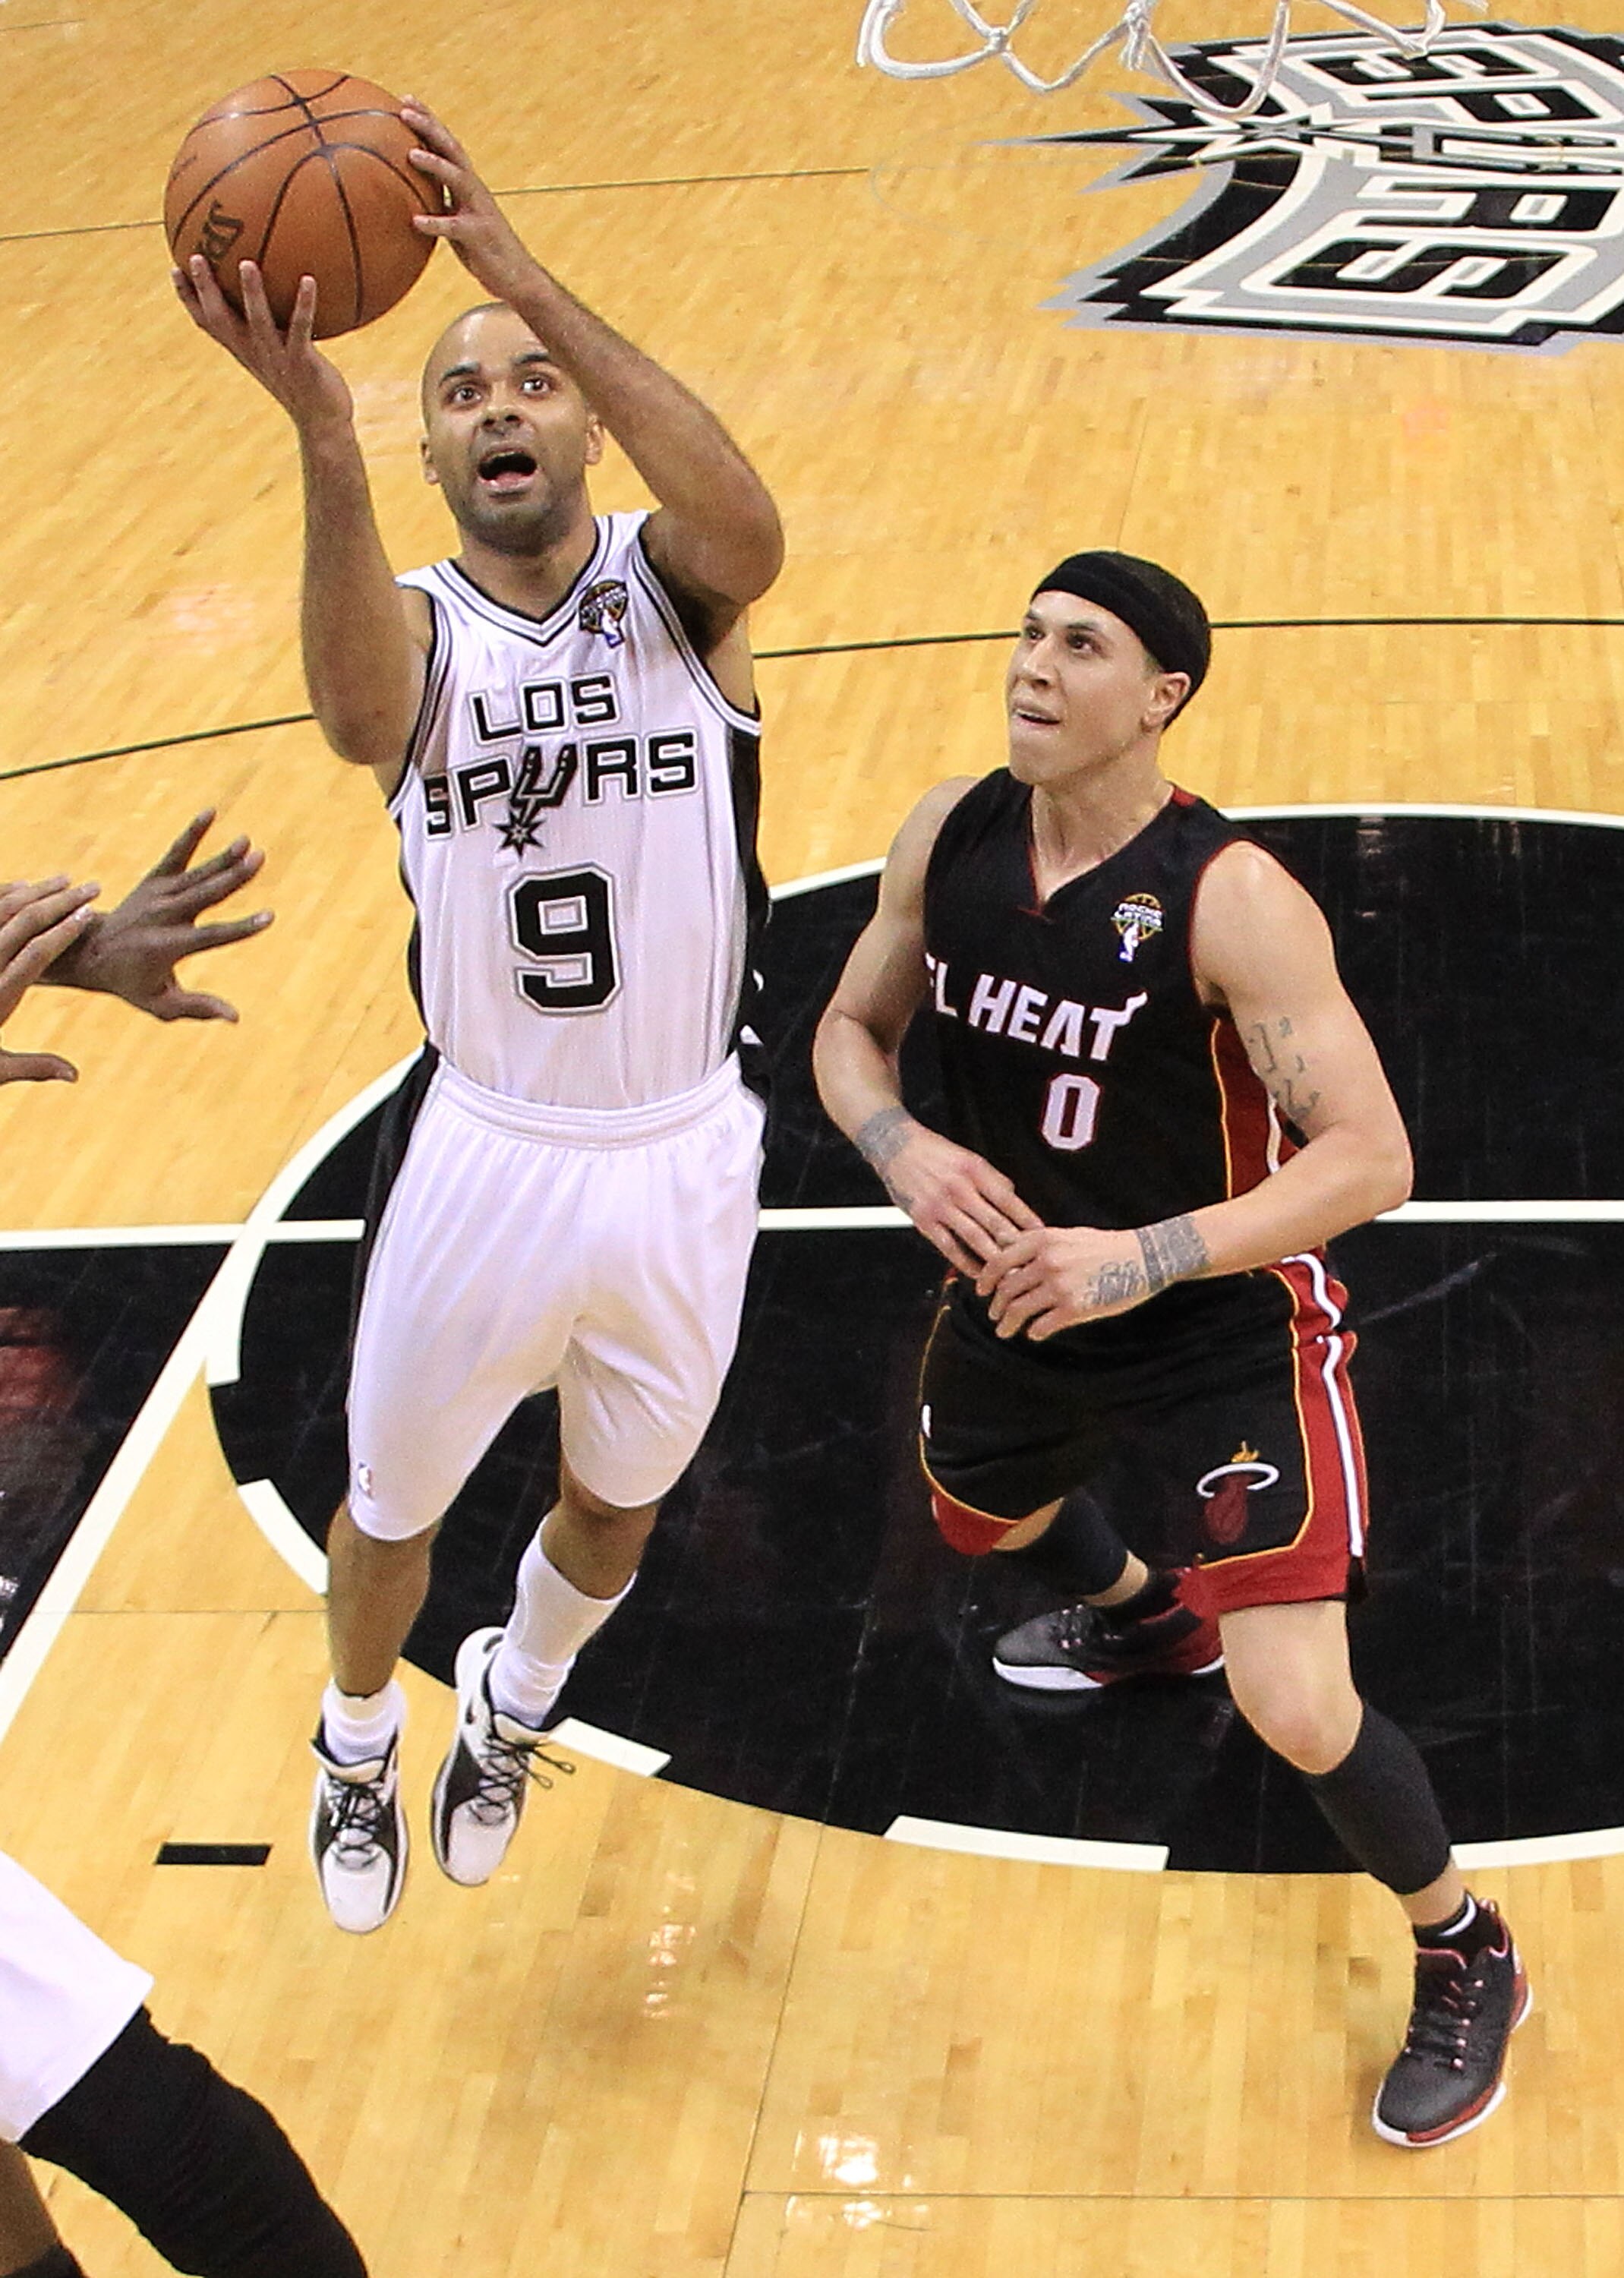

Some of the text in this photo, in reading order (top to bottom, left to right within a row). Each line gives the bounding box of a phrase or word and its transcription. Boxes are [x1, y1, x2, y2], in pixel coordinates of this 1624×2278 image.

[469, 671, 620, 745] LOS
[421, 728, 698, 856] SPURS
[507, 863, 622, 1013] 9
[967, 973, 1149, 1062] HEAT
[1041, 1072, 1102, 1152] 0
